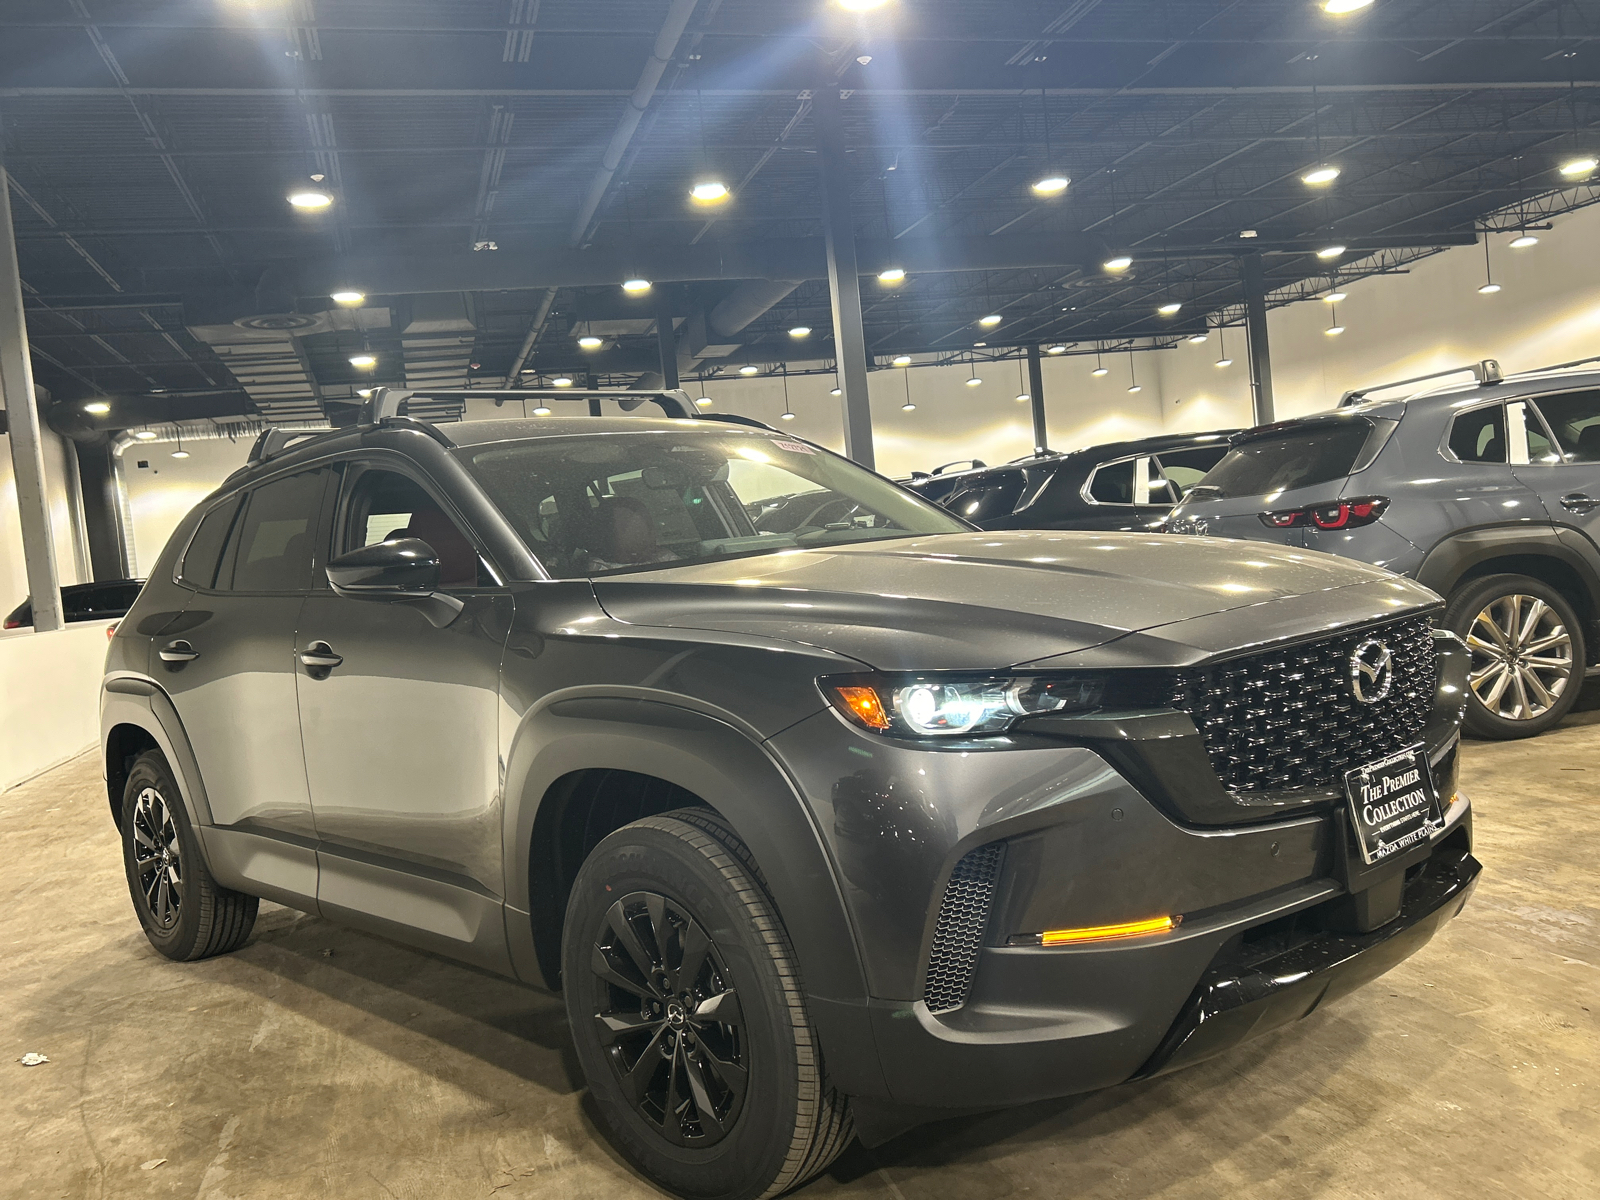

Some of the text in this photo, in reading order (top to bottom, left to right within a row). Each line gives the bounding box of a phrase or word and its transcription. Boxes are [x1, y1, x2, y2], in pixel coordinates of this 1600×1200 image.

[1361, 769, 1421, 804] THE PREMIER
[1363, 788, 1427, 826] COLLECTION
[1399, 832, 1417, 848] WHITE
